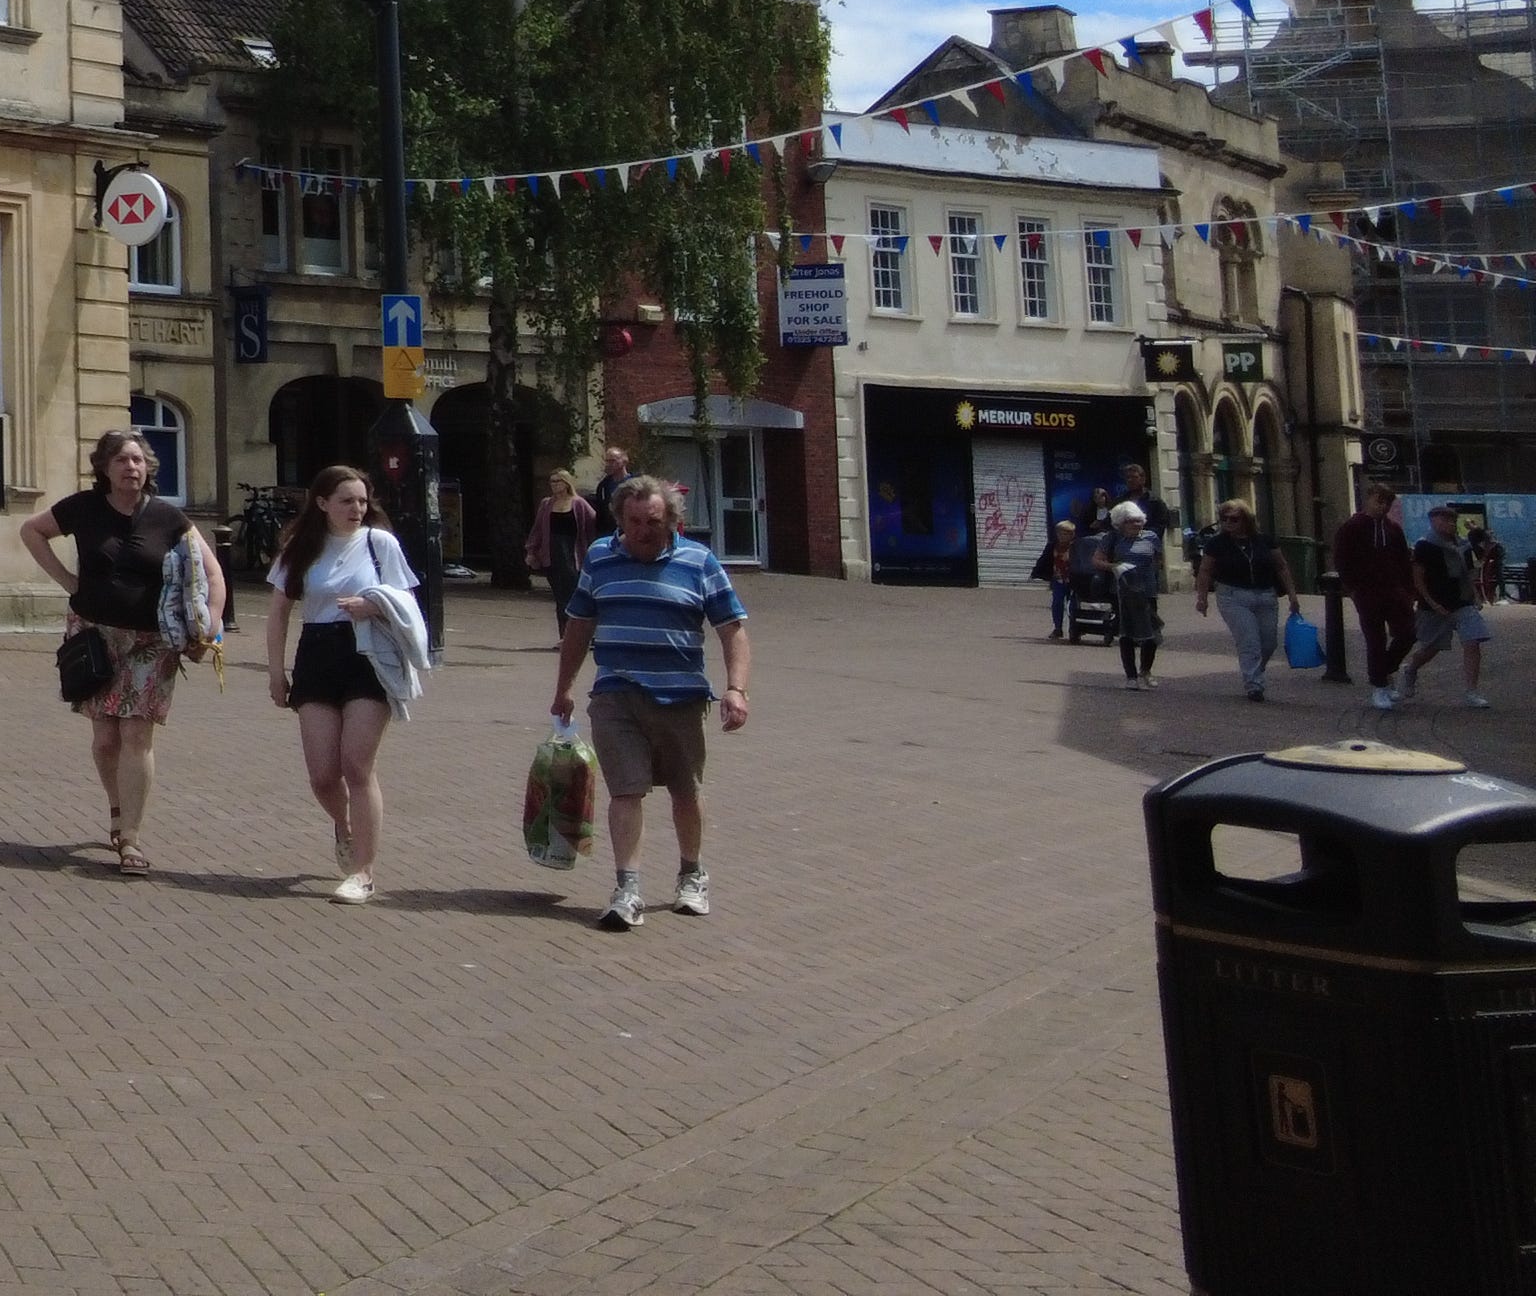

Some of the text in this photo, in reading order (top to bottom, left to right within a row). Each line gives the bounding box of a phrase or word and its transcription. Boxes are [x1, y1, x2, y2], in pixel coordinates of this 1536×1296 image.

[784, 290, 844, 299] FREEHOLD
[799, 304, 830, 312] SHOP
[787, 315, 843, 325] FOR SALE
[152, 319, 204, 345] HART
[423, 354, 458, 371] mith
[1225, 352, 1256, 373] PP
[978, 410, 1076, 428] MERKUR SLOTS
